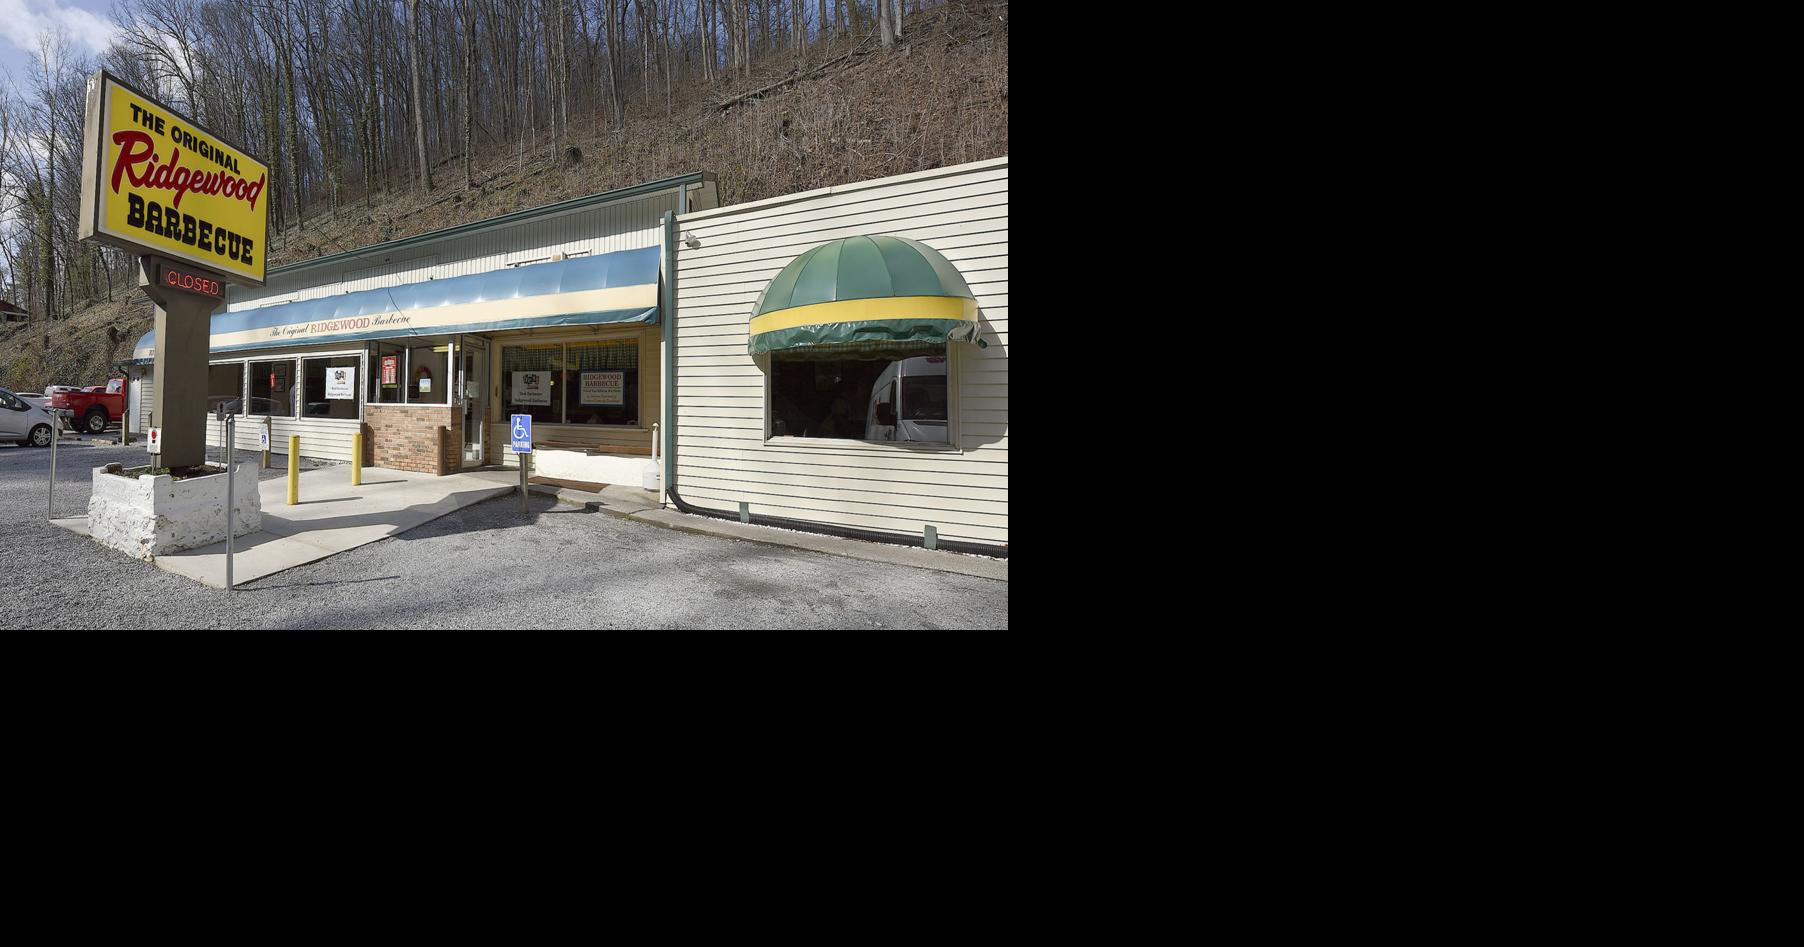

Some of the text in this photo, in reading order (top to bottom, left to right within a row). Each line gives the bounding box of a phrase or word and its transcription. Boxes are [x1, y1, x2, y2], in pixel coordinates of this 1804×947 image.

[112, 130, 265, 212] Ridgewood
[130, 103, 240, 175] THE ORIGINAL
[127, 192, 253, 266] BARBECUE
[167, 270, 219, 296] CLOSED
[270, 314, 411, 338] The Original RIDGEWOOD Barbecue
